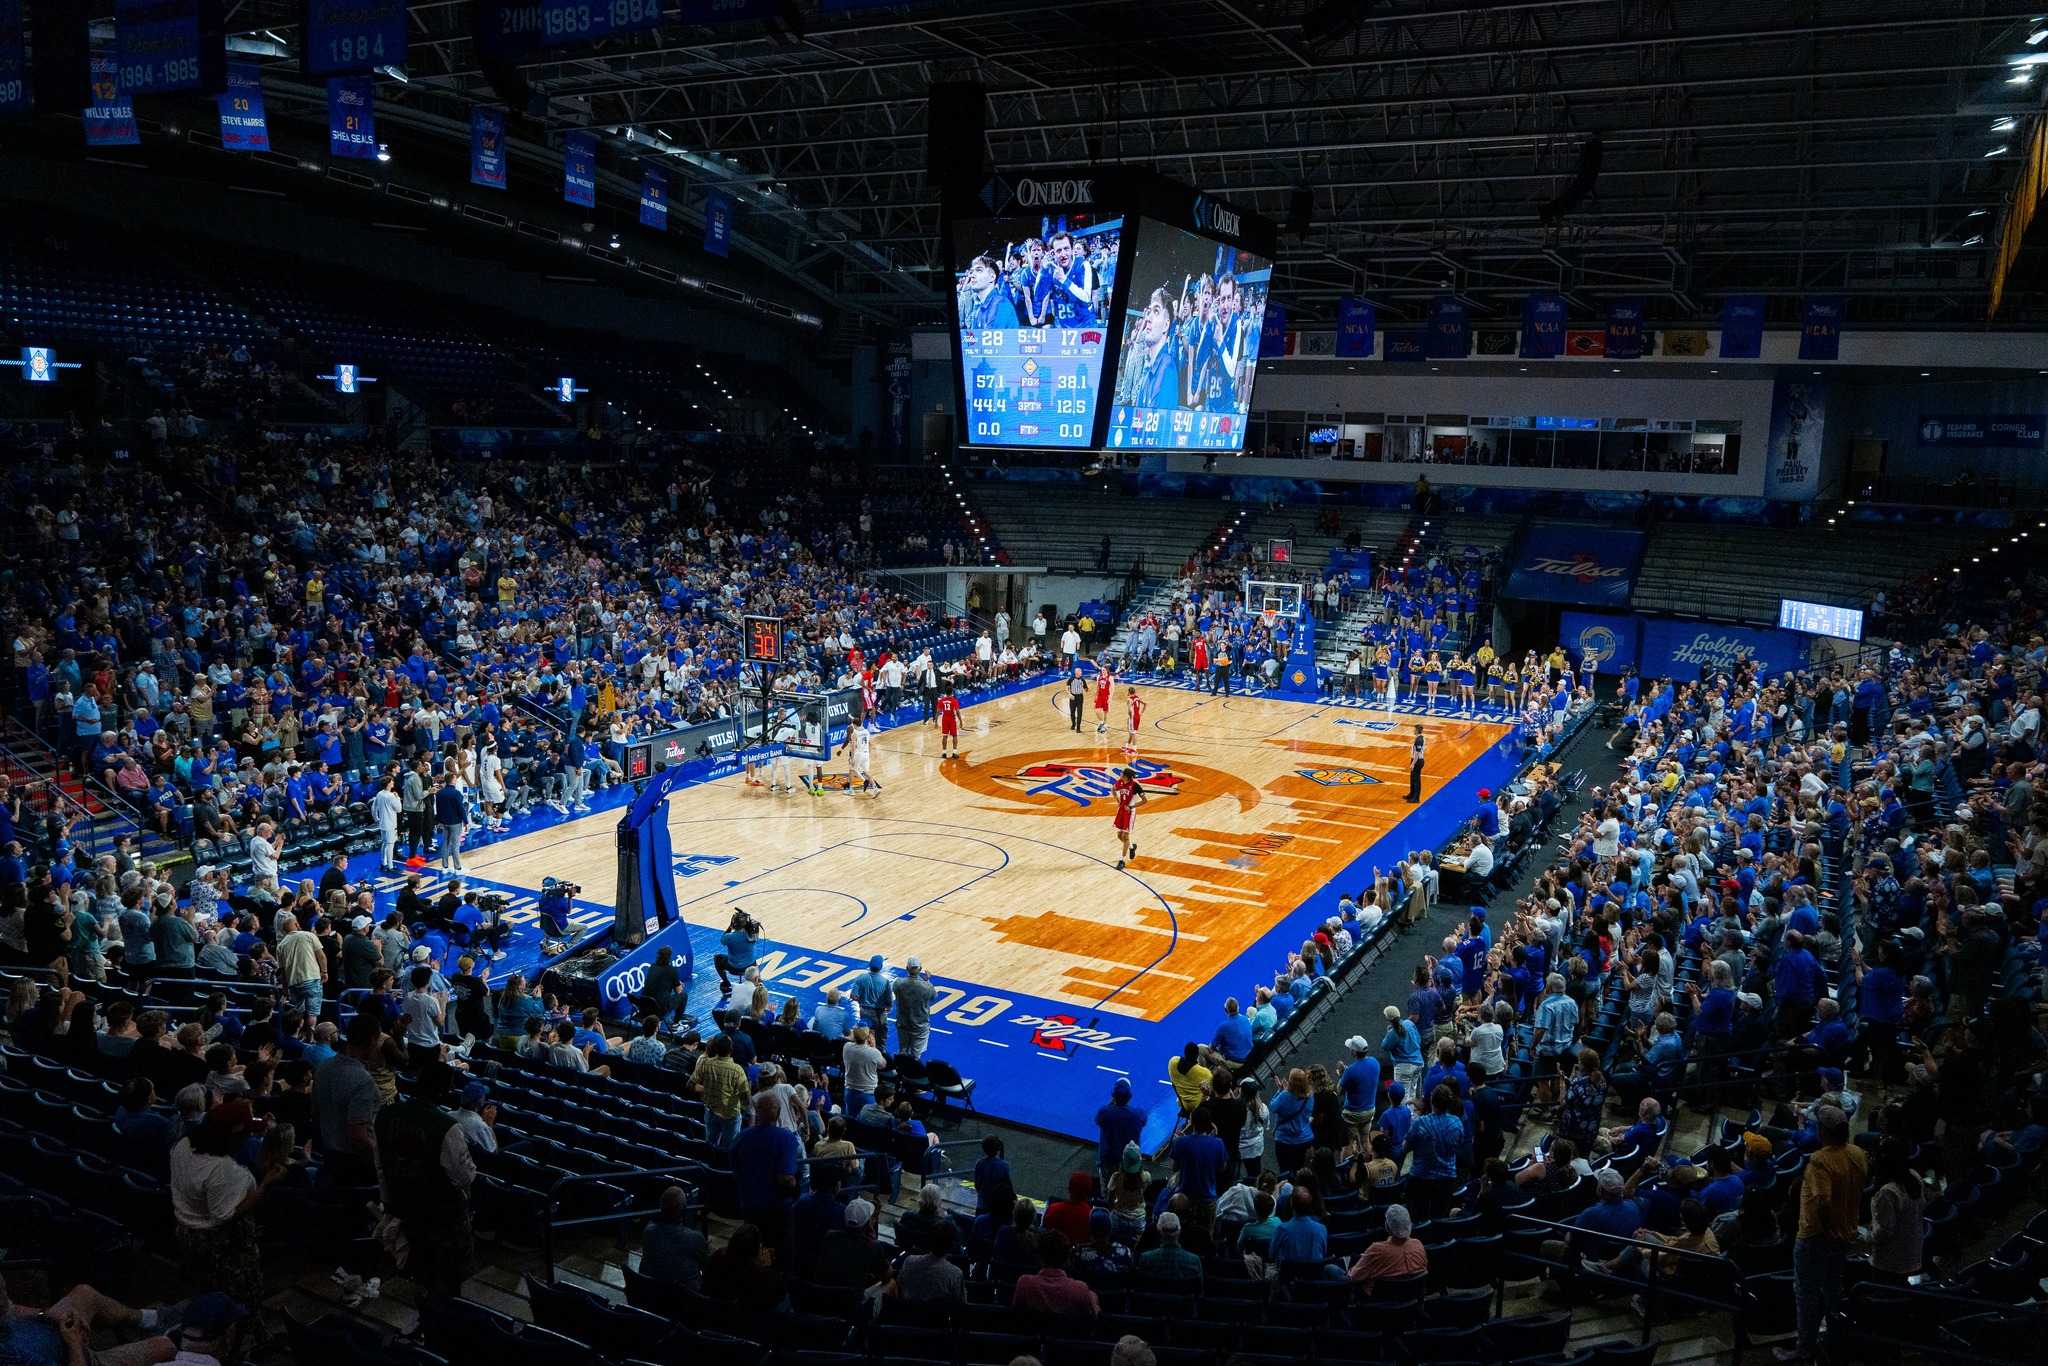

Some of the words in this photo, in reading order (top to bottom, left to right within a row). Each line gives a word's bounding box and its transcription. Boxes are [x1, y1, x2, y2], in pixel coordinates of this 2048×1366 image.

[330, 32, 384, 63] 1984
[234, 98, 249, 110] 20
[85, 106, 110, 119] WILLIE
[221, 115, 242, 126] STEVE
[243, 118, 265, 127] HARRIS
[346, 115, 359, 130] 21
[351, 134, 374, 145] SEALS
[1016, 178, 1093, 207] ONEOK
[714, 211, 724, 223] 32
[1213, 203, 1241, 237] ONEOK
[1345, 324, 1369, 334] NCAA
[1437, 323, 1462, 334] NCAA
[1535, 322, 1560, 333] NCAA
[1610, 325, 1638, 336] NCAA
[1805, 325, 1836, 336] NCAA
[982, 331, 1003, 346] 28
[1018, 329, 1046, 343] 5:41
[1061, 330, 1078, 346] 17
[976, 375, 1004, 389] 57.1
[1021, 378, 1040, 387] FG%
[1057, 376, 1087, 389] 38.1
[973, 399, 1006, 412] 44.4
[1017, 402, 1041, 411] 3PT%
[1057, 400, 1086, 414] 12.5
[978, 422, 1000, 436] 0.0
[1145, 412, 1159, 432] 28
[1173, 412, 1194, 432] 5:41
[1209, 416, 1220, 434] 17
[1991, 423, 2027, 432] CORNER
[1020, 426, 1039, 434] FT%
[1059, 424, 1083, 438] 0.0
[2017, 431, 2041, 439] CLUB
[114, 450, 129, 459] 104
[1776, 466, 1809, 477] PRESSEY
[1524, 557, 1627, 577] Tulsa
[1807, 620, 1818, 630] 28
[1821, 622, 1830, 632] 17
[754, 634, 776, 657] 30
[1571, 634, 1625, 649] HURRICANE
[1693, 633, 1756, 657] Golden
[1672, 644, 1768, 672] Hurrice
[828, 702, 849, 717] UNLV
[665, 746, 685, 759] Tulsa
[632, 760, 645, 776] 30
[1473, 951, 1484, 971] 12
[1008, 1014, 1138, 1051] Tulsa
